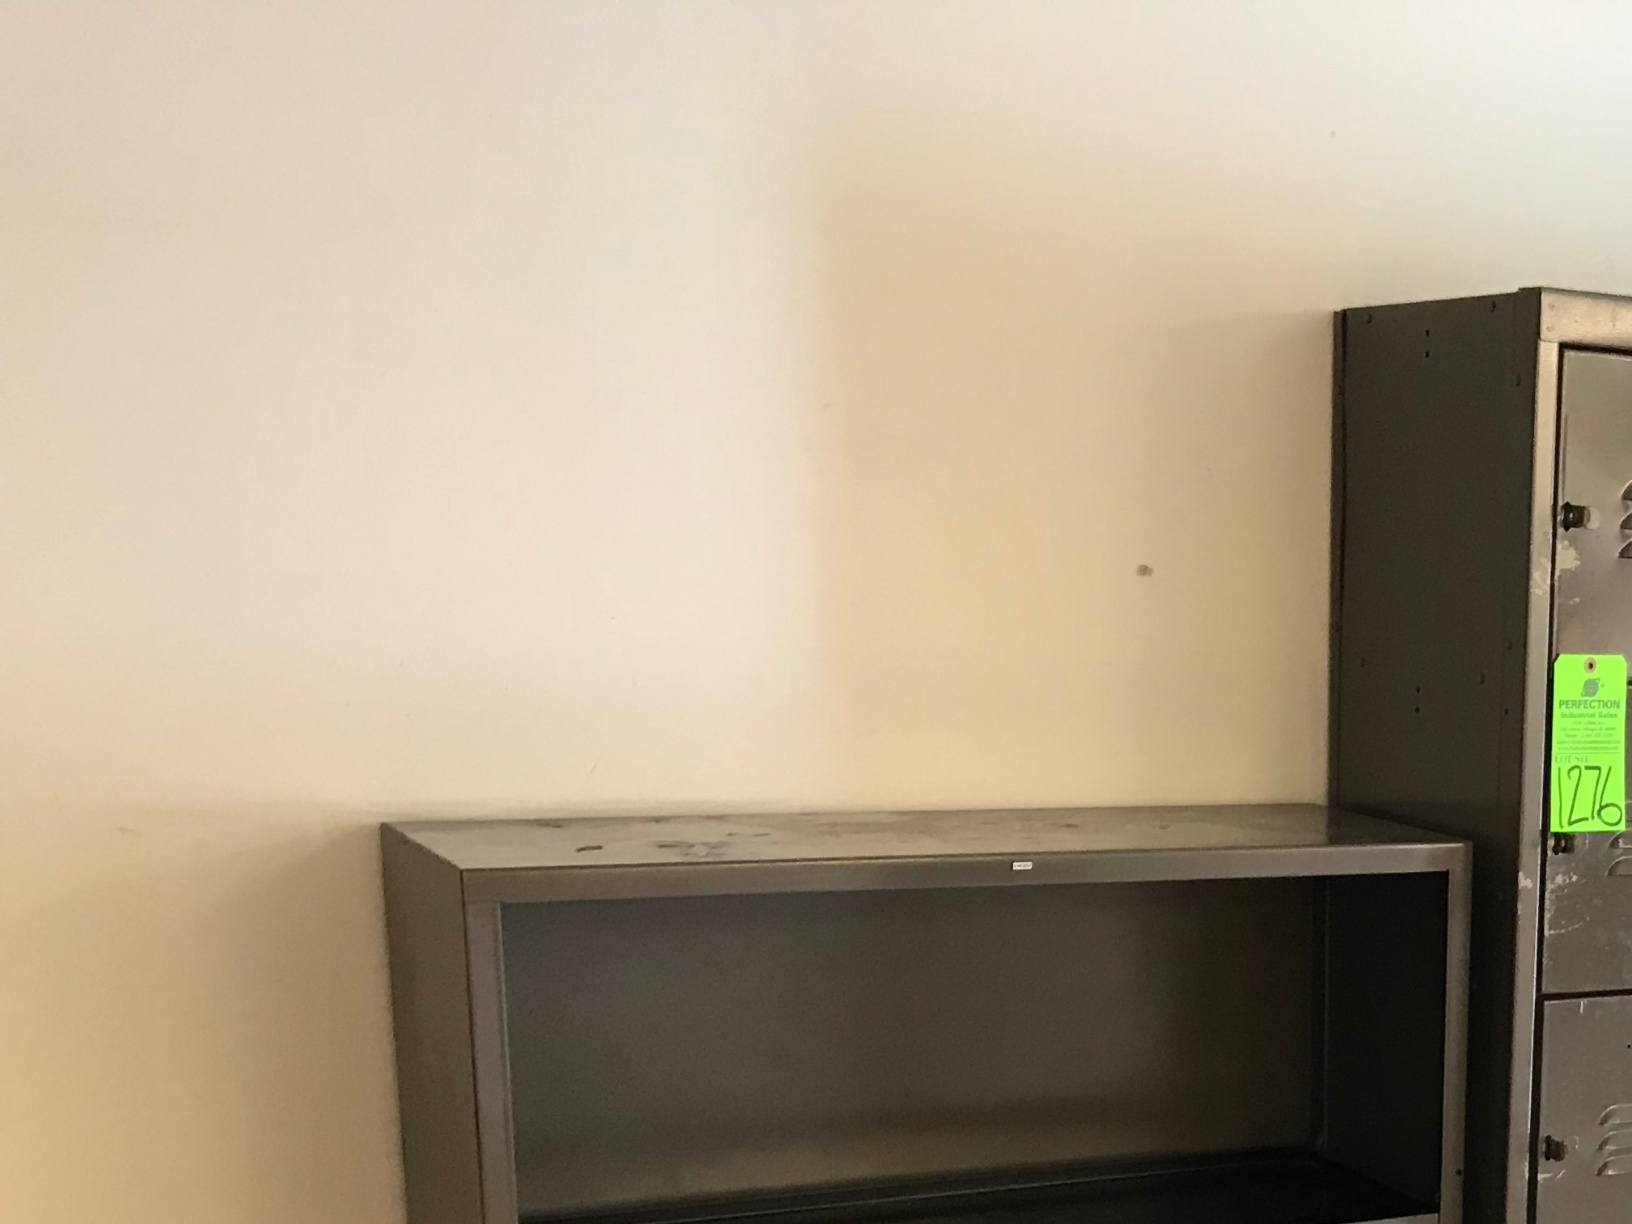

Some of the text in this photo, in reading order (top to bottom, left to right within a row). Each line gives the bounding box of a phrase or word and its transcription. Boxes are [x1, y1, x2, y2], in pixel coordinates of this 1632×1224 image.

[1559, 700, 1620, 709] PERFECTION
[1554, 755, 1590, 764] LOT NO.
[1558, 765, 1622, 829] 1276
